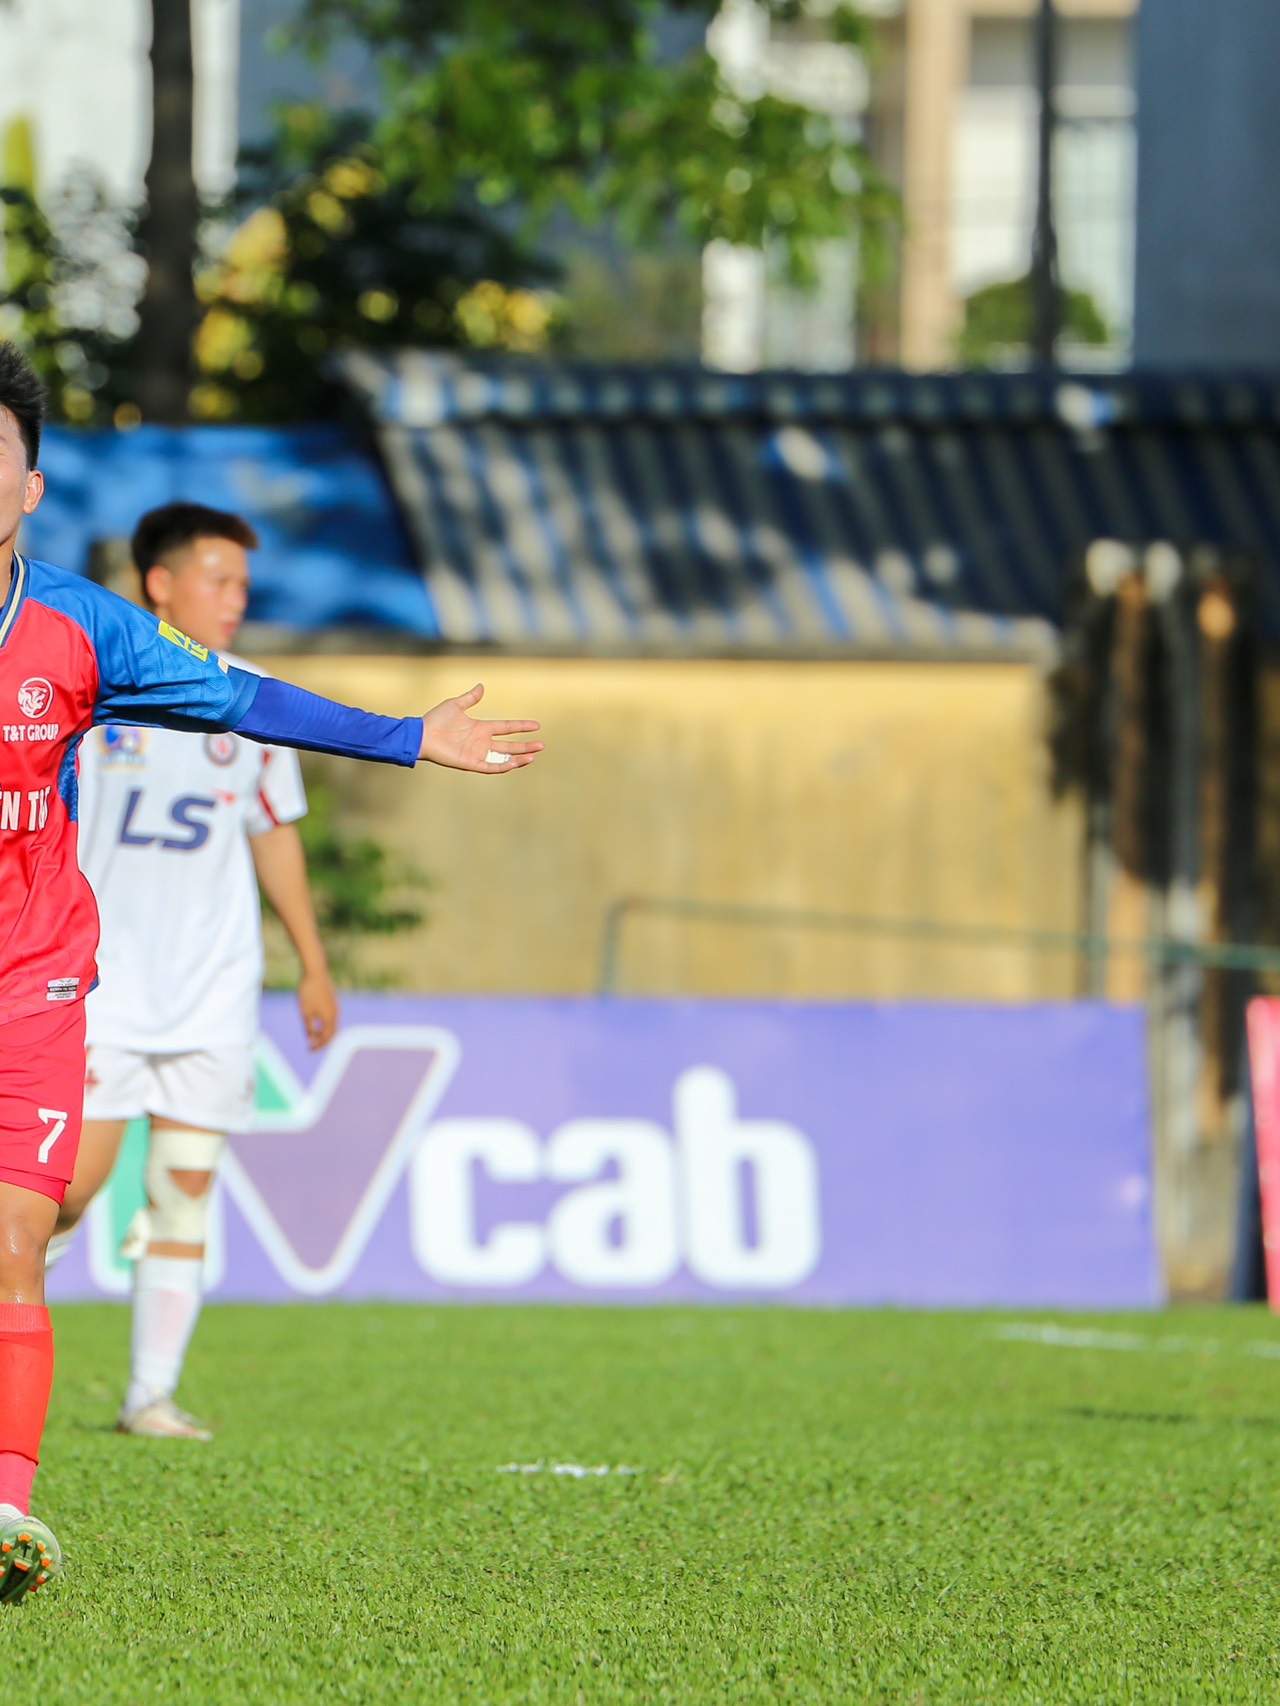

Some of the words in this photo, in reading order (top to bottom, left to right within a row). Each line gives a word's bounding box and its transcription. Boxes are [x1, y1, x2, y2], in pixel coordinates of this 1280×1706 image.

[2, 725, 26, 742] T&T
[27, 723, 60, 741] GROUP
[120, 791, 216, 852] LS
[37, 1107, 69, 1165] 7
